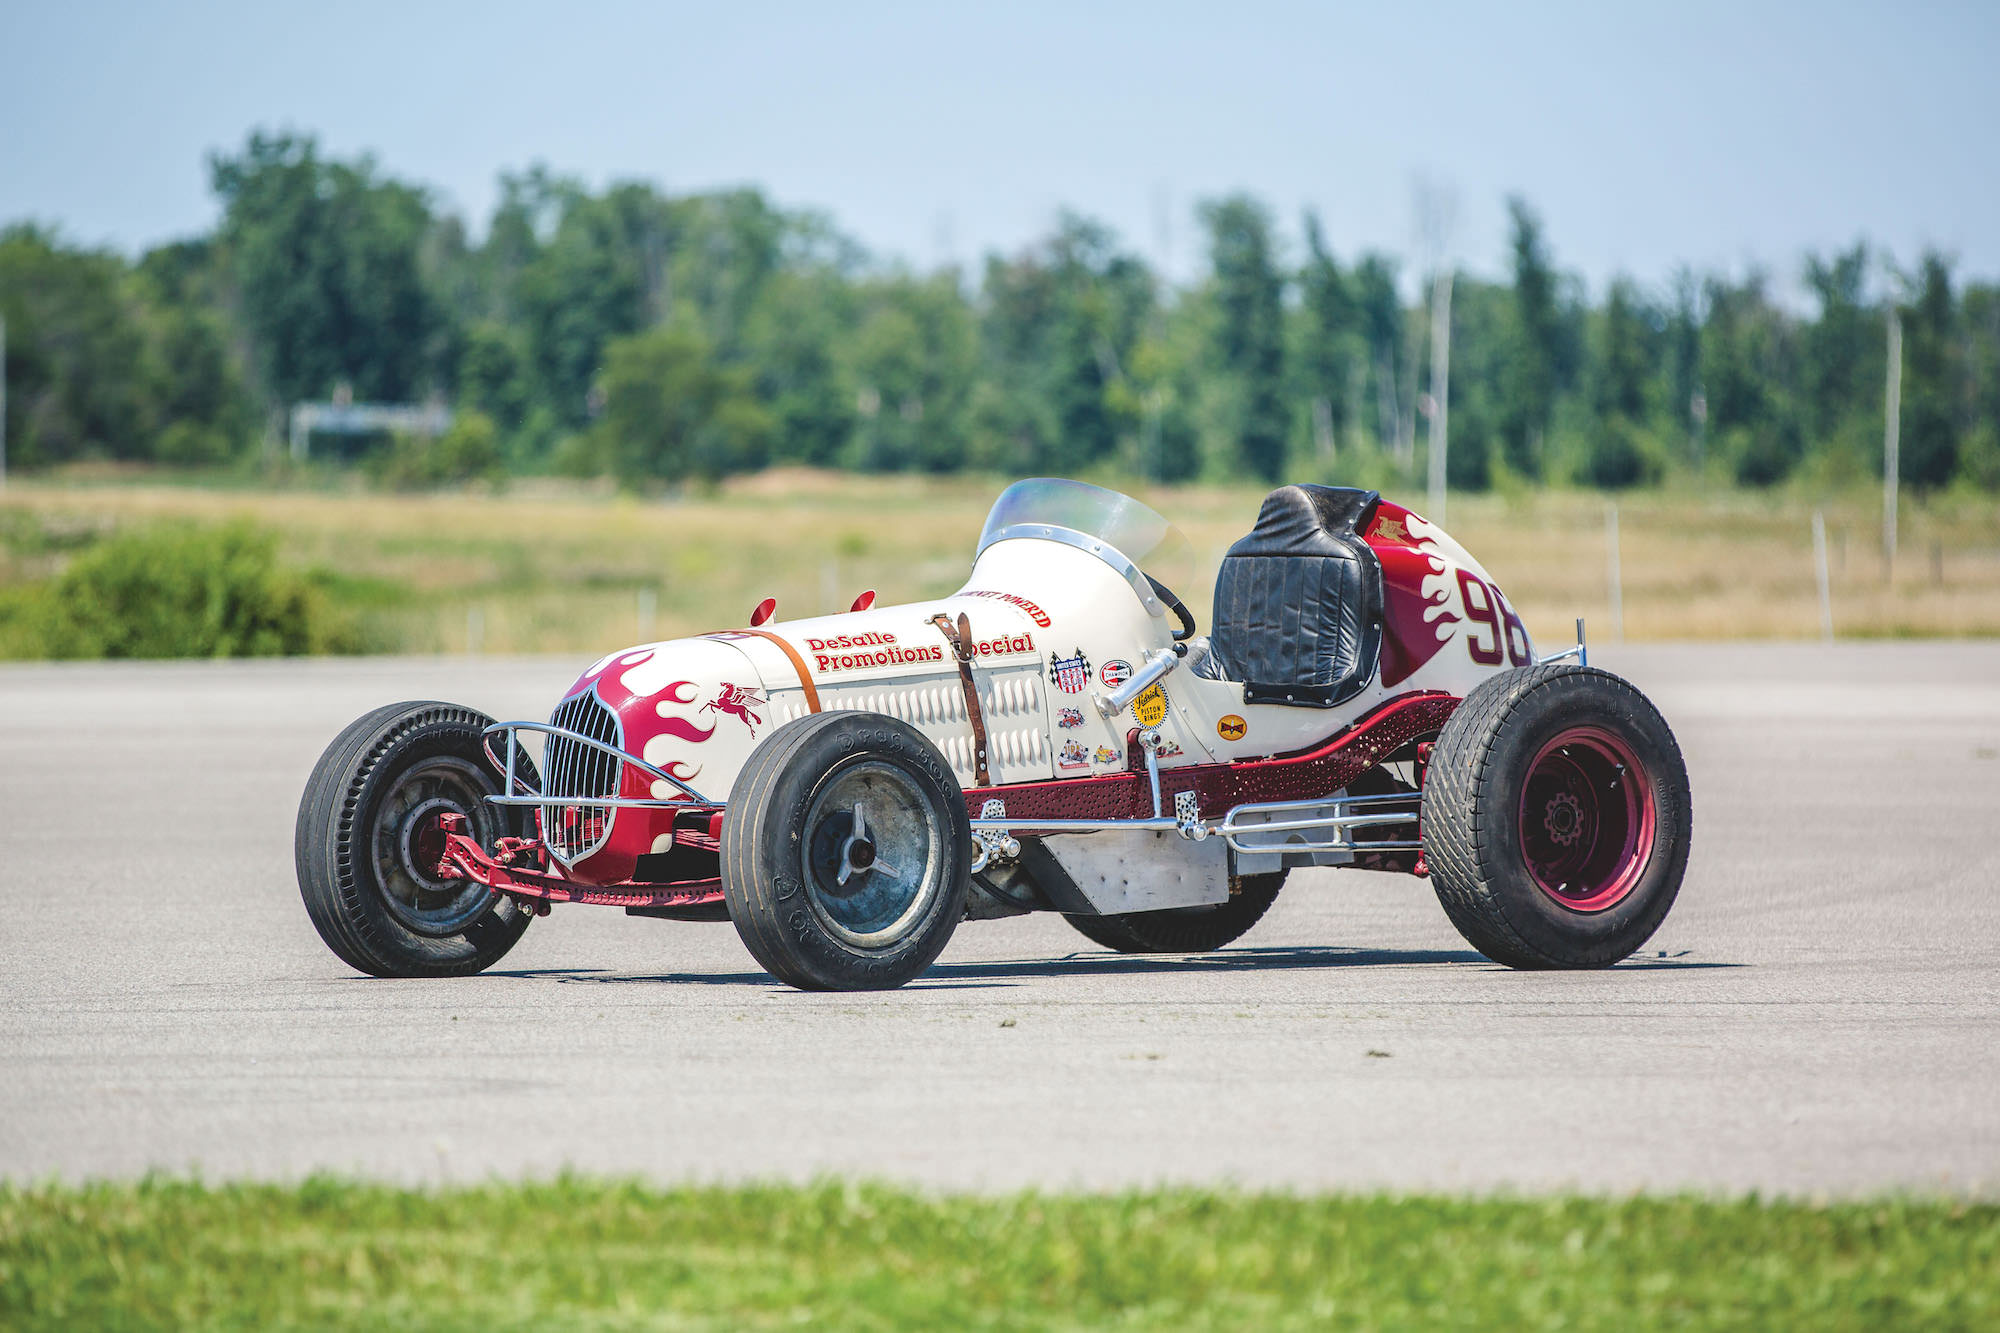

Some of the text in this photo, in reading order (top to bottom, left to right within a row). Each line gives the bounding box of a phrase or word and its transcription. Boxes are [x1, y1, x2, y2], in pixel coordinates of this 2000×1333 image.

[999, 593, 1051, 628] POWERED
[1455, 567, 1533, 667] 98
[805, 632, 898, 652] DeSalle
[816, 632, 1036, 673] Promotions ecial
[1061, 669, 1082, 680] AUTO
[1105, 671, 1129, 679] CHAMPION
[1062, 677, 1083, 688] CLUB
[1141, 705, 1161, 715] PISTON
[1144, 712, 1161, 722] RINGS
